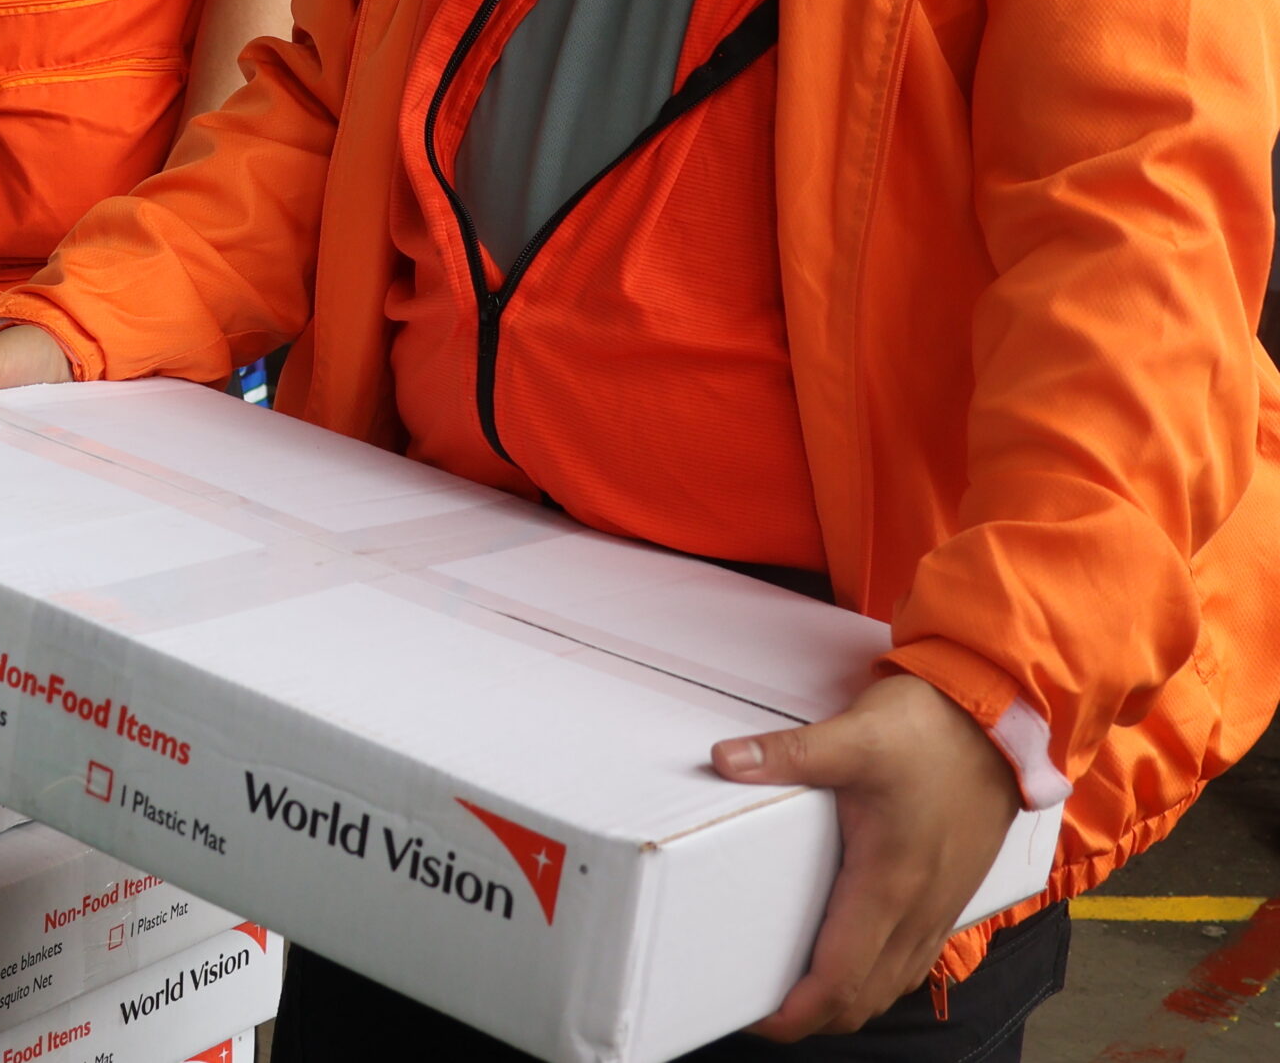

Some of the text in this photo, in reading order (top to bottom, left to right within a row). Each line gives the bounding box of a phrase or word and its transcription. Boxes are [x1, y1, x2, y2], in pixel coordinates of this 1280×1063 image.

[116, 705, 190, 765] Items
[132, 790, 186, 836] Plastic
[192, 819, 226, 855] Mat
[245, 771, 513, 920] World Vision
[44, 883, 119, 933] Non-Food
[137, 911, 167, 935] Plastic
[170, 902, 188, 919] Mat
[21, 942, 63, 972] blankets
[33, 974, 53, 992] Net
[120, 949, 249, 1025] World Vision
[48, 1021, 91, 1052] Items
